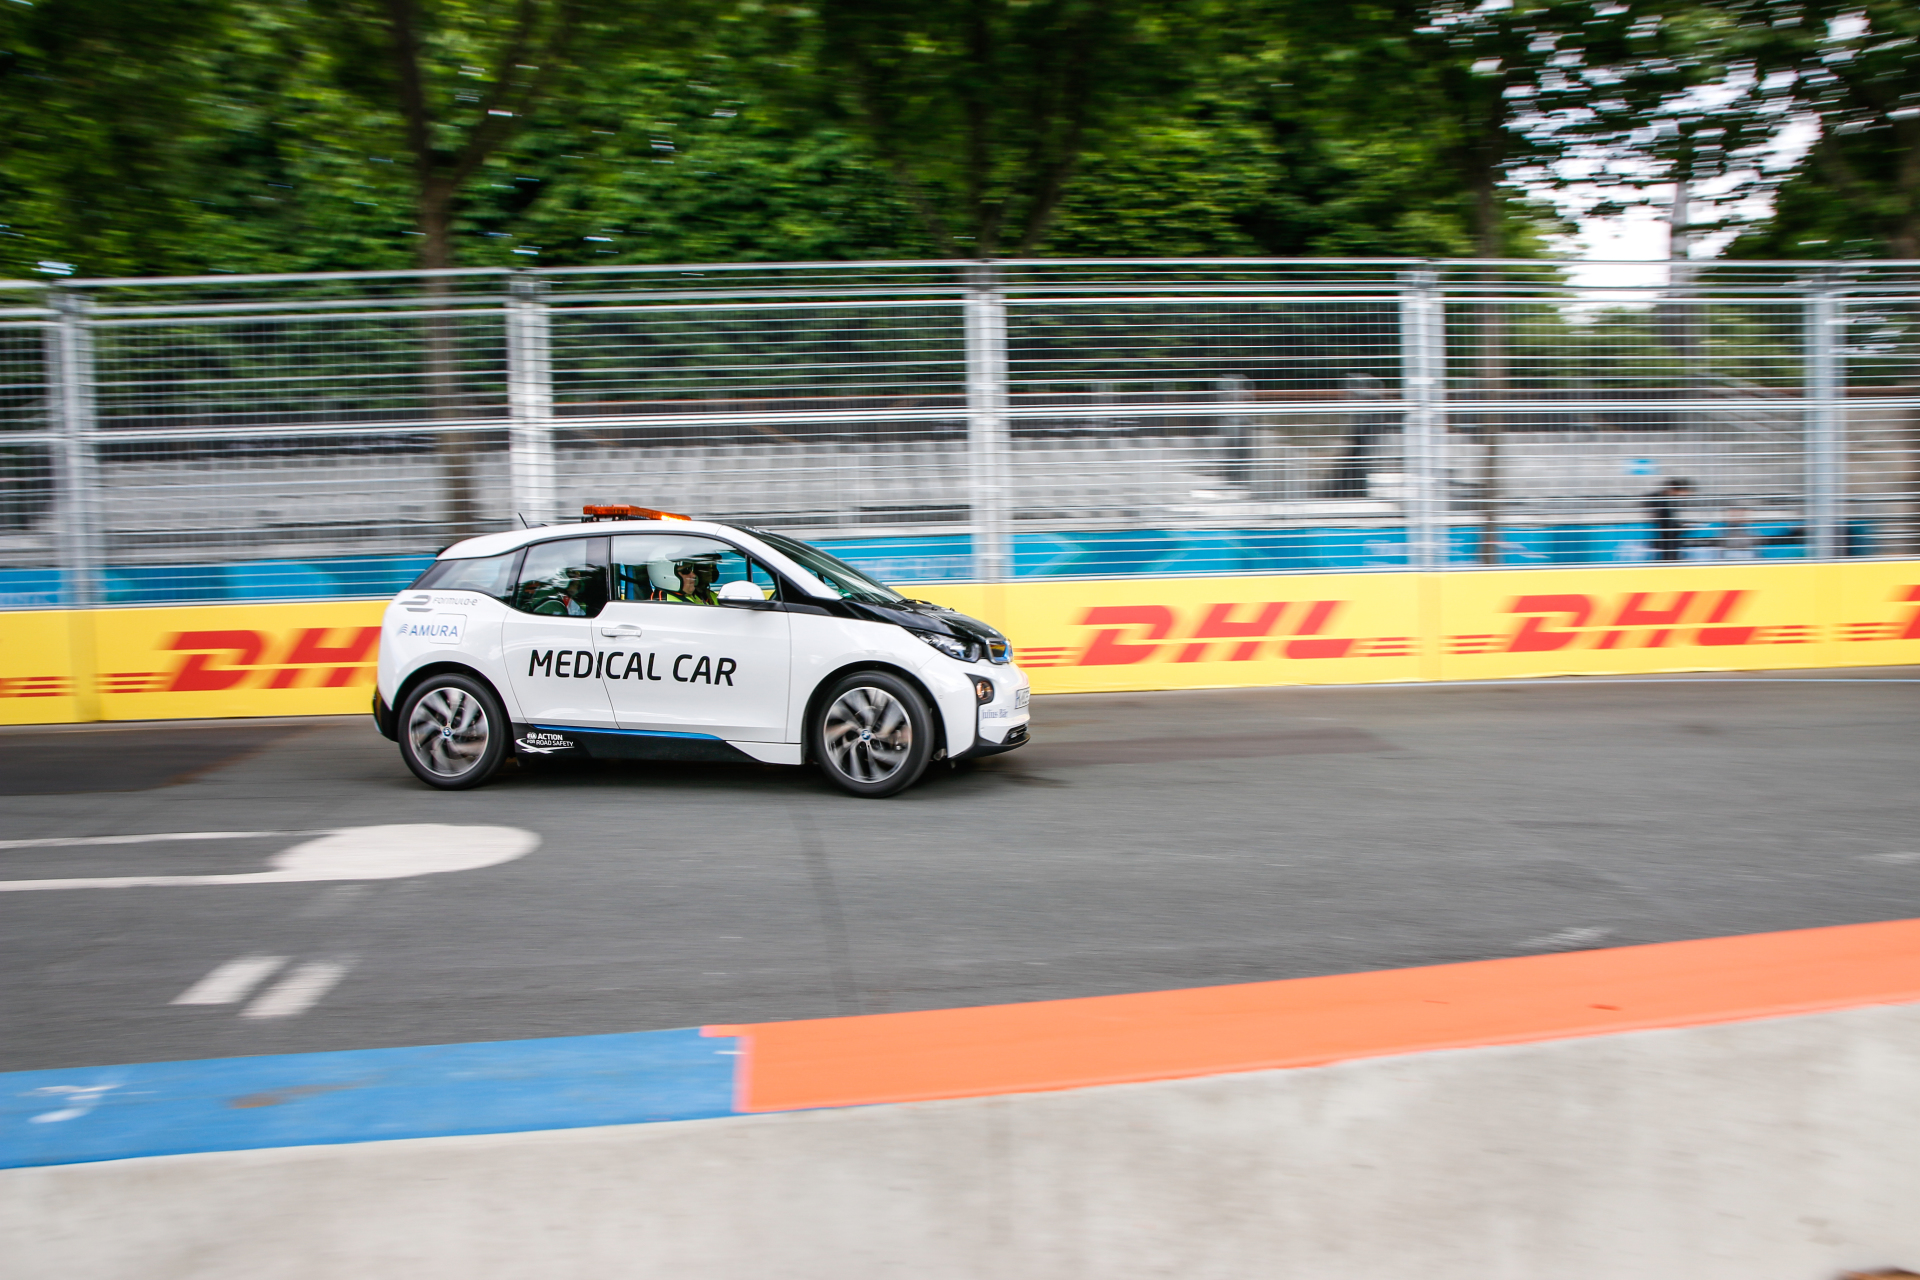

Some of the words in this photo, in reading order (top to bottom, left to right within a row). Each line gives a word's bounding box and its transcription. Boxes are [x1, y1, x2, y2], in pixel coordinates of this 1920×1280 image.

[409, 625, 458, 637] AMURA
[1074, 600, 1353, 667] DHL
[1502, 590, 1757, 653] DHL
[166, 626, 382, 692] DH
[528, 649, 662, 680] MEDICAL
[672, 654, 737, 686] CAR
